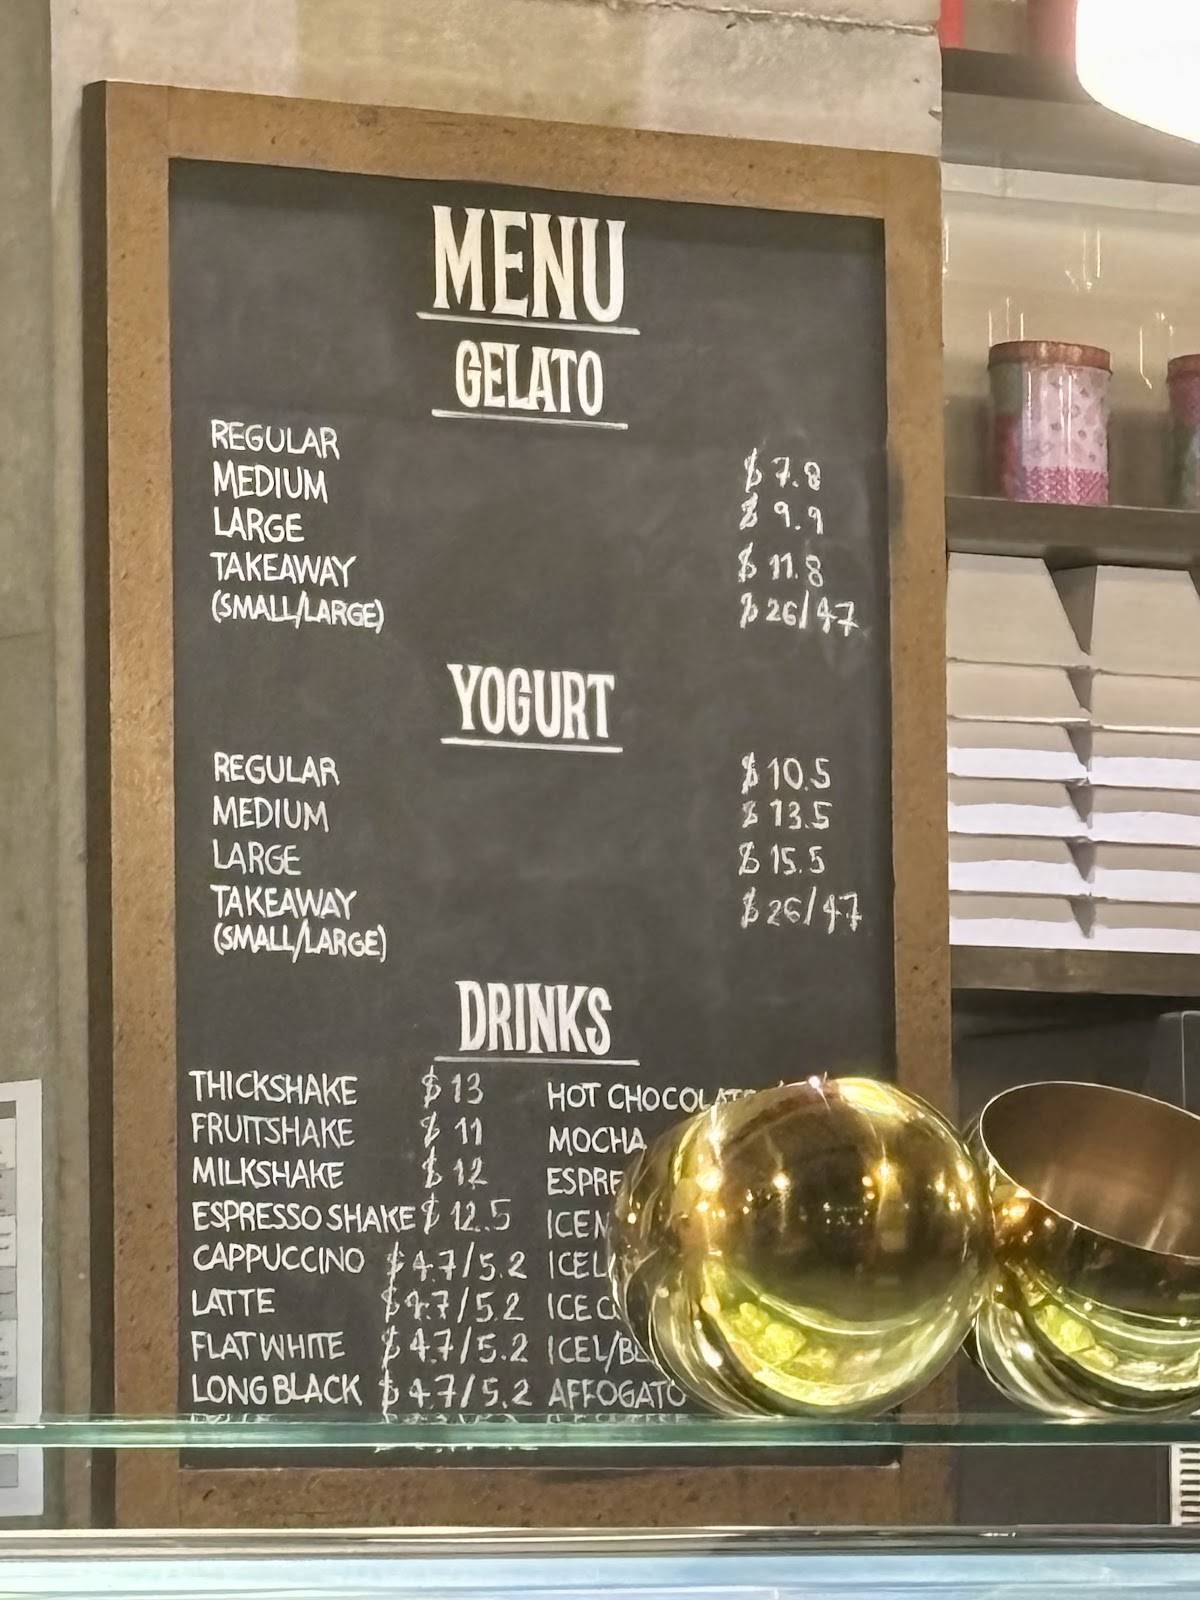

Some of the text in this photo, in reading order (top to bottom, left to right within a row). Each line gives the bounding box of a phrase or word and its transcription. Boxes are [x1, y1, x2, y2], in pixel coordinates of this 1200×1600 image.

[432, 204, 627, 322] MENU
[455, 339, 605, 417] GELATO
[210, 418, 341, 461] REGULAR
[212, 460, 329, 505] MEDIUM
[212, 506, 305, 544] LARGE
[209, 551, 358, 589] TAKEAWAY
[210, 589, 386, 635] (SMALL/LARGE)
[446, 663, 617, 741] YOGURT
[213, 751, 341, 787] REGULAR
[212, 795, 330, 832] MEDIUM
[212, 838, 302, 876] LARGE
[209, 883, 358, 921] TAKEAWAY
[213, 918, 388, 964] (SMALL/LARGE)
[454, 979, 613, 1056] DRINKS
[188, 1069, 359, 1108] THICKSHAKE
[546, 1081, 602, 1113] HOT
[191, 1111, 356, 1149] FRUITSHAKE
[548, 1125, 647, 1157] MOCHA
[192, 1156, 345, 1190] MILKSHAKE
[192, 1200, 323, 1234] ESPRESSO
[325, 1203, 417, 1235] SHAKE
[192, 1241, 366, 1275] CAPPUCCINO
[191, 1287, 276, 1317] LATTE
[190, 1330, 257, 1363] FLAT
[259, 1330, 346, 1362] WHITE
[191, 1373, 268, 1406] LONG
[271, 1371, 363, 1407] BLACK
[548, 1377, 688, 1411] AFFOGATO
